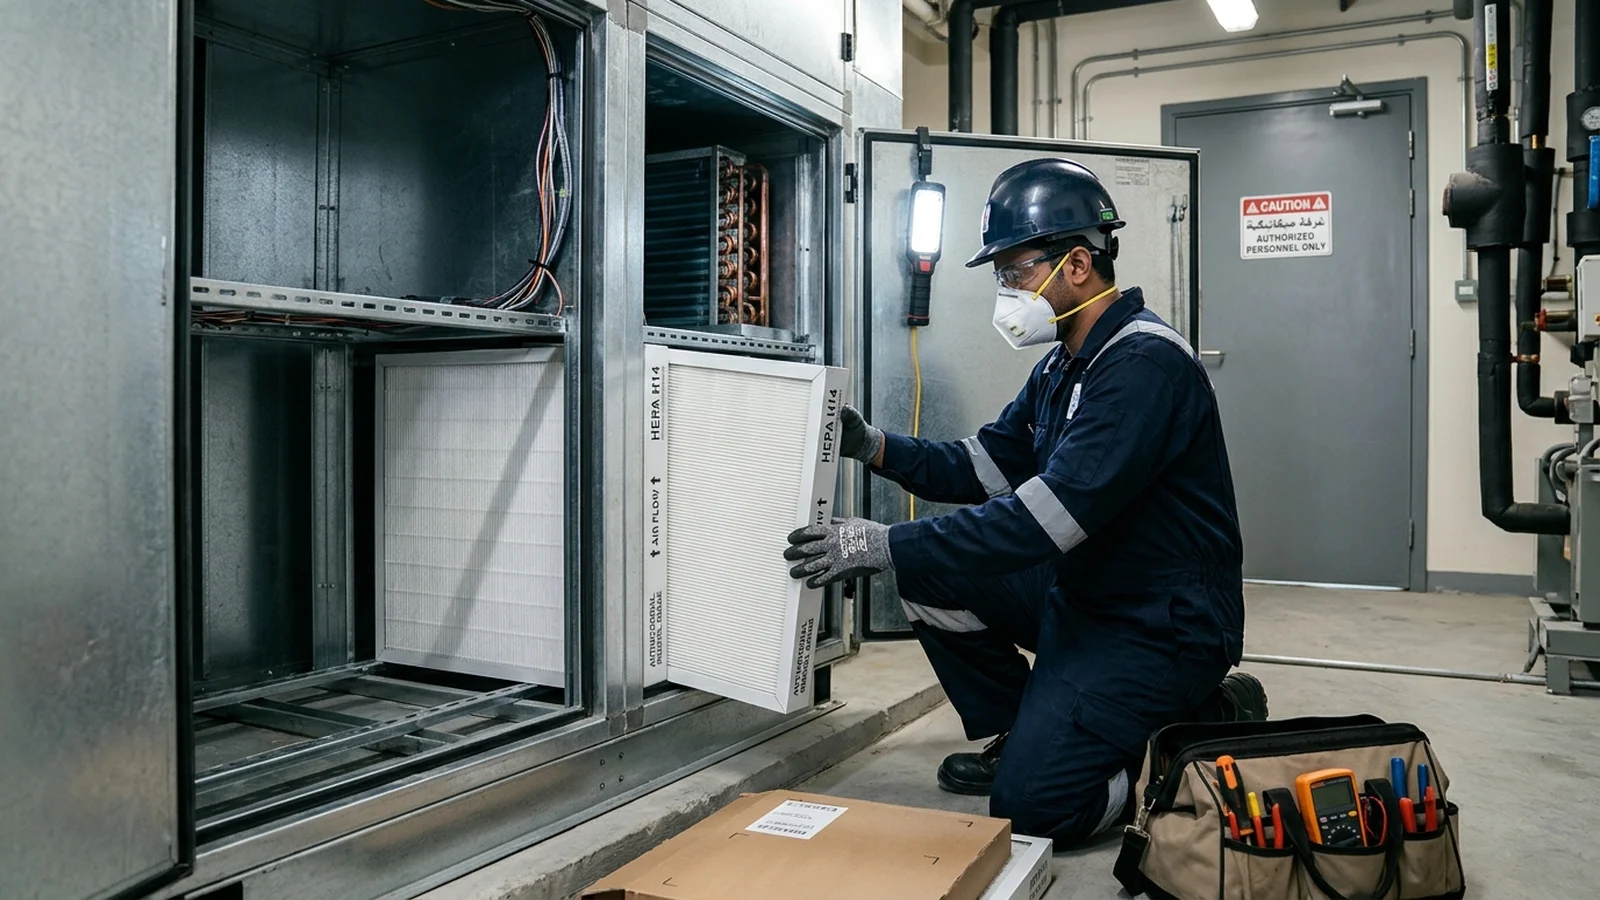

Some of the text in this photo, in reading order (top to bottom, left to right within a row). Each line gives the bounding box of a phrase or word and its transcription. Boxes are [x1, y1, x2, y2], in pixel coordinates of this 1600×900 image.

[1260, 199, 1310, 213] CAUTION
[1257, 232, 1315, 243] AUTHORIZED
[1246, 242, 1326, 254] PERSONNEL ONLY
[821, 421, 834, 463] HEPA
